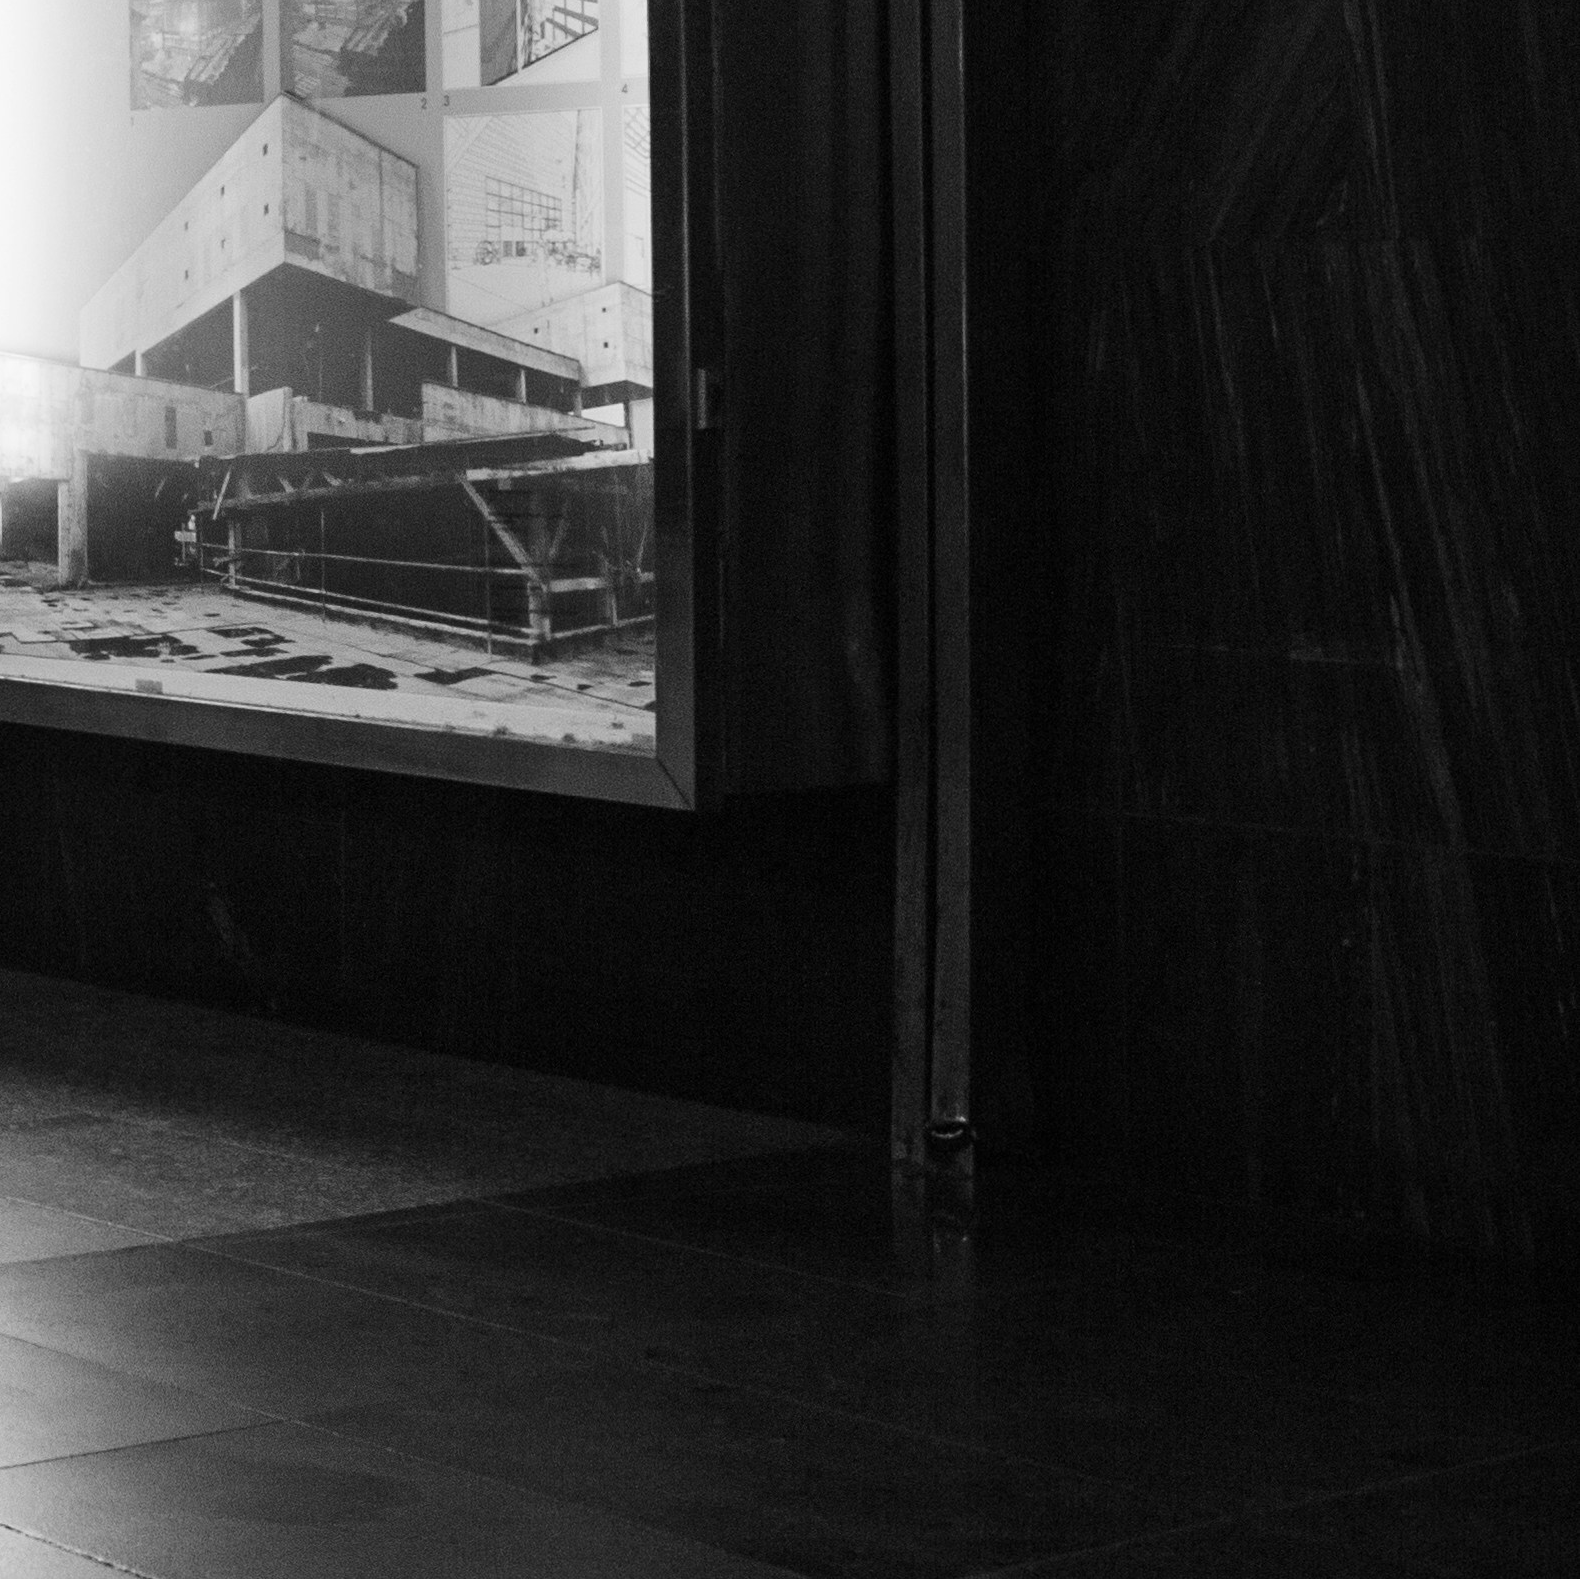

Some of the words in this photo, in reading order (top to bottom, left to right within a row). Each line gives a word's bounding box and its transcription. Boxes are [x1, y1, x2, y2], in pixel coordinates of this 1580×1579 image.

[621, 83, 629, 94] 4
[421, 98, 427, 110] 2
[443, 95, 450, 107] 3
